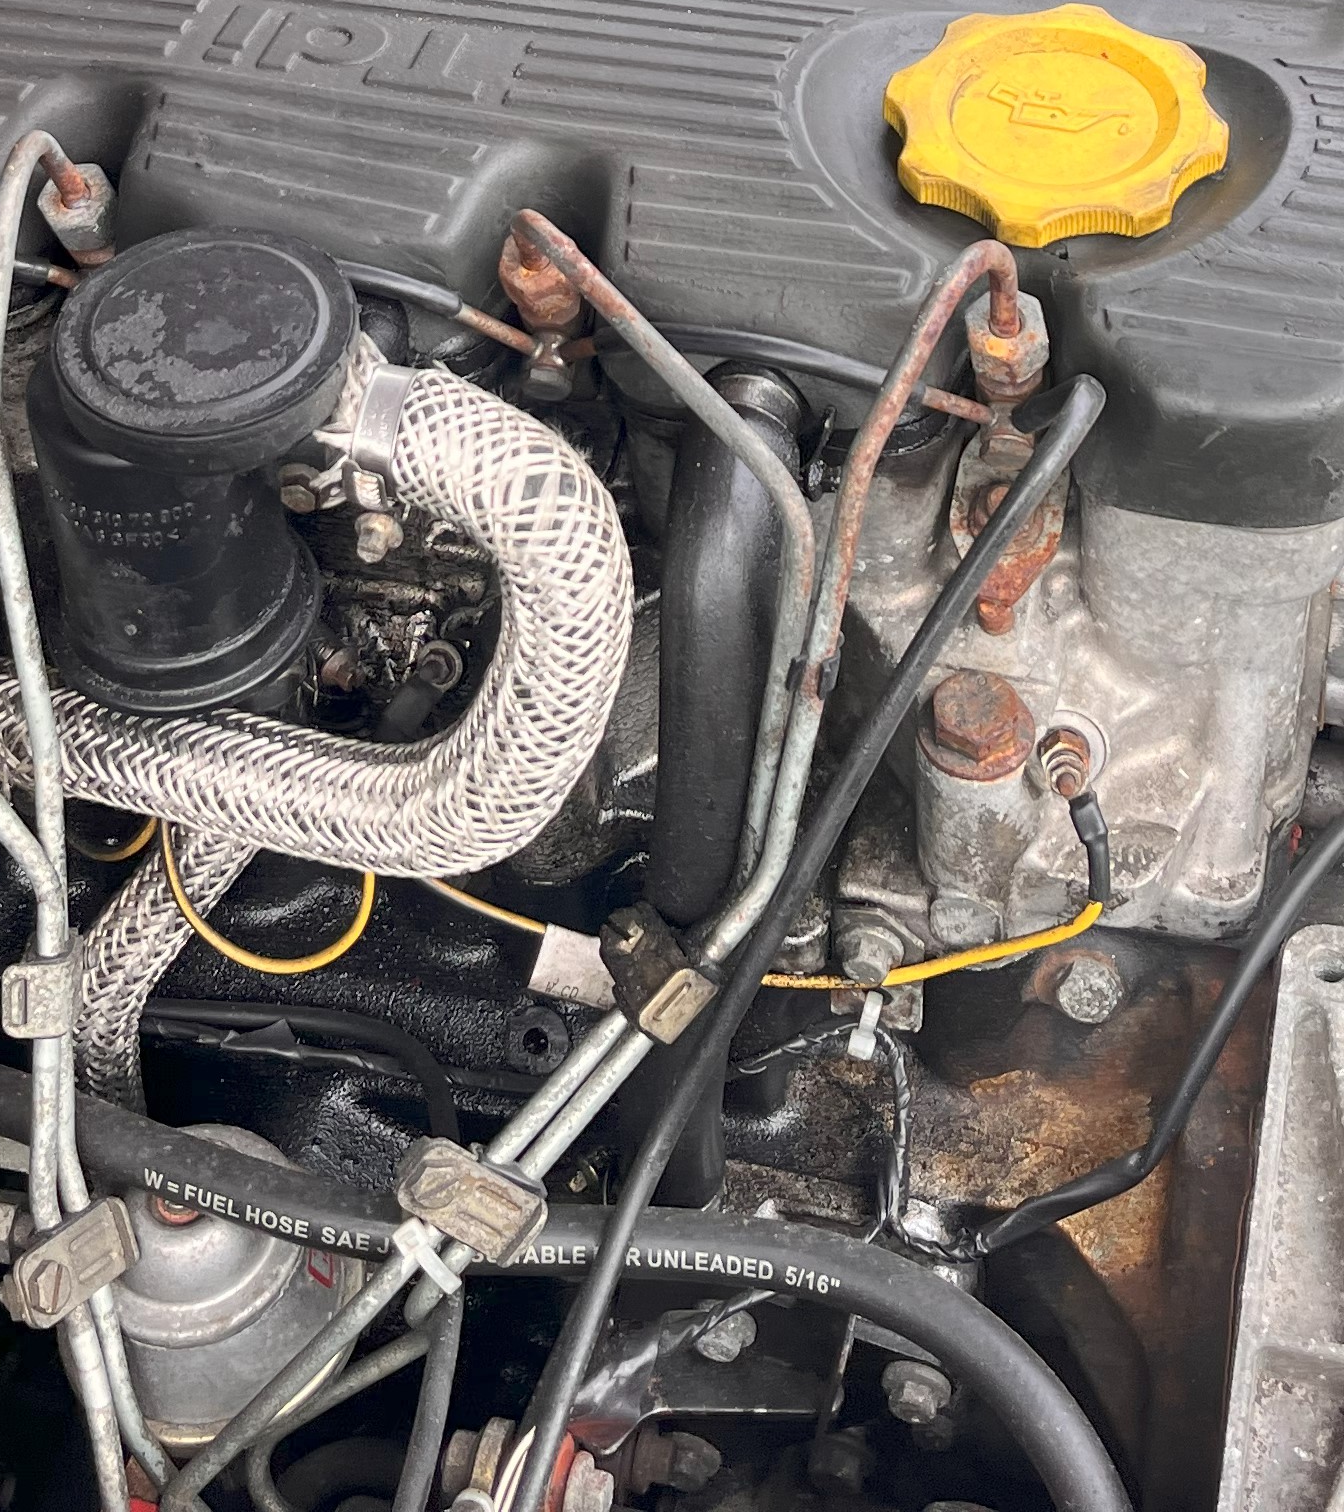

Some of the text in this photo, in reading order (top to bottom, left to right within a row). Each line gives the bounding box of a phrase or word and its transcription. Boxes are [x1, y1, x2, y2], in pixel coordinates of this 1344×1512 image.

[144, 1167, 164, 1190] W
[183, 1183, 240, 1219] FUEL
[245, 1204, 310, 1239] HOSE
[320, 1226, 371, 1252] SAE
[647, 1248, 774, 1280] UNLEADED
[784, 1265, 841, 1294] 5/16"
